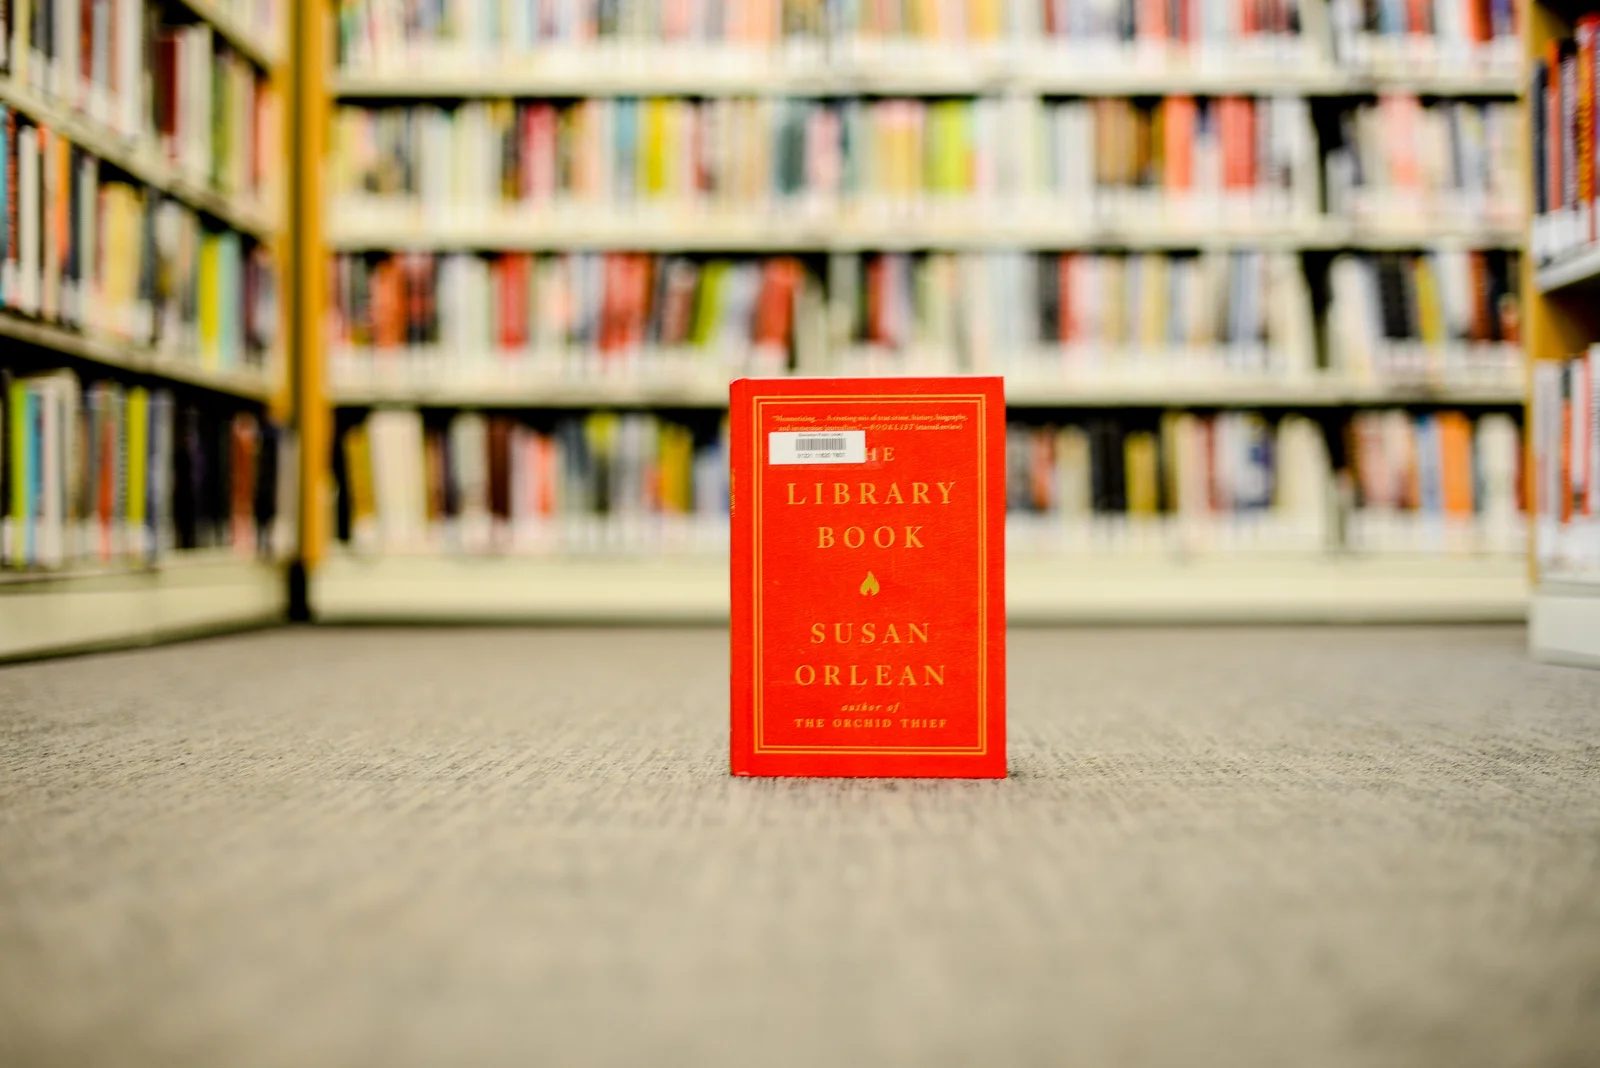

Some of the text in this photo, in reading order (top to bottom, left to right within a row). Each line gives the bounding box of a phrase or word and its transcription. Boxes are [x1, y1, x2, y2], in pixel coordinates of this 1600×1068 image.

[864, 447, 895, 462] HE
[787, 481, 956, 505] LIBRARY
[816, 526, 925, 549] BOOK
[810, 622, 929, 644] SUSAN
[794, 664, 945, 686] ORLEAN
[840, 702, 901, 714] author of
[794, 718, 947, 728] THE ORCHID THIEF
